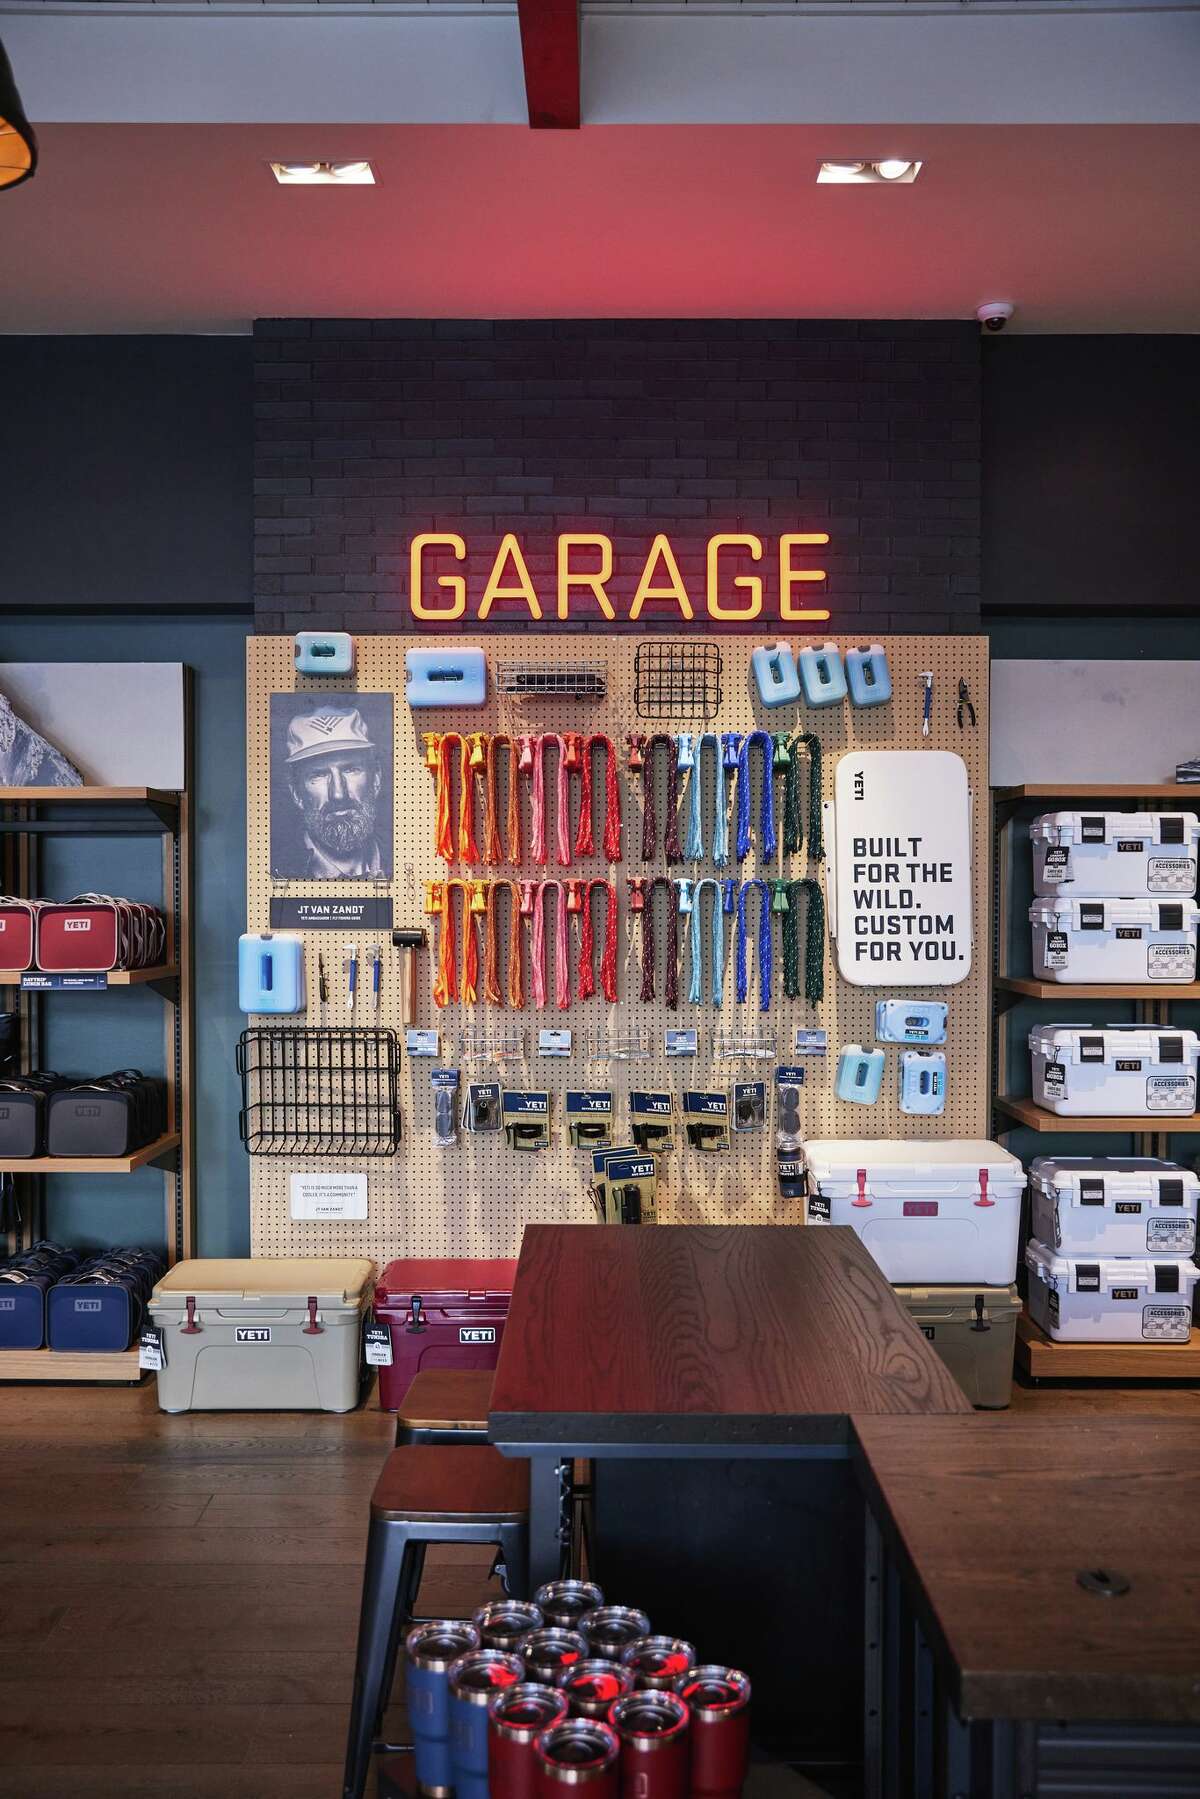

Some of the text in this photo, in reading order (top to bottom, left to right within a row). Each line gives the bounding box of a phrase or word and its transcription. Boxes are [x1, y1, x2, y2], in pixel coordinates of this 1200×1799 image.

[411, 534, 830, 620] GARAGE
[854, 771, 864, 800] YETI
[853, 838, 922, 857] BUILT
[854, 863, 952, 883] FOR THE
[854, 890, 922, 909] WILD.
[298, 906, 364, 914] JT VAN ZANDT
[854, 915, 954, 935] CUSTOM
[855, 941, 964, 961] FOR YOU.
[631, 1164, 653, 1173] YETI
[77, 1302, 99, 1310] YETI
[238, 1330, 268, 1340] YETI
[462, 1331, 492, 1340] YETI
